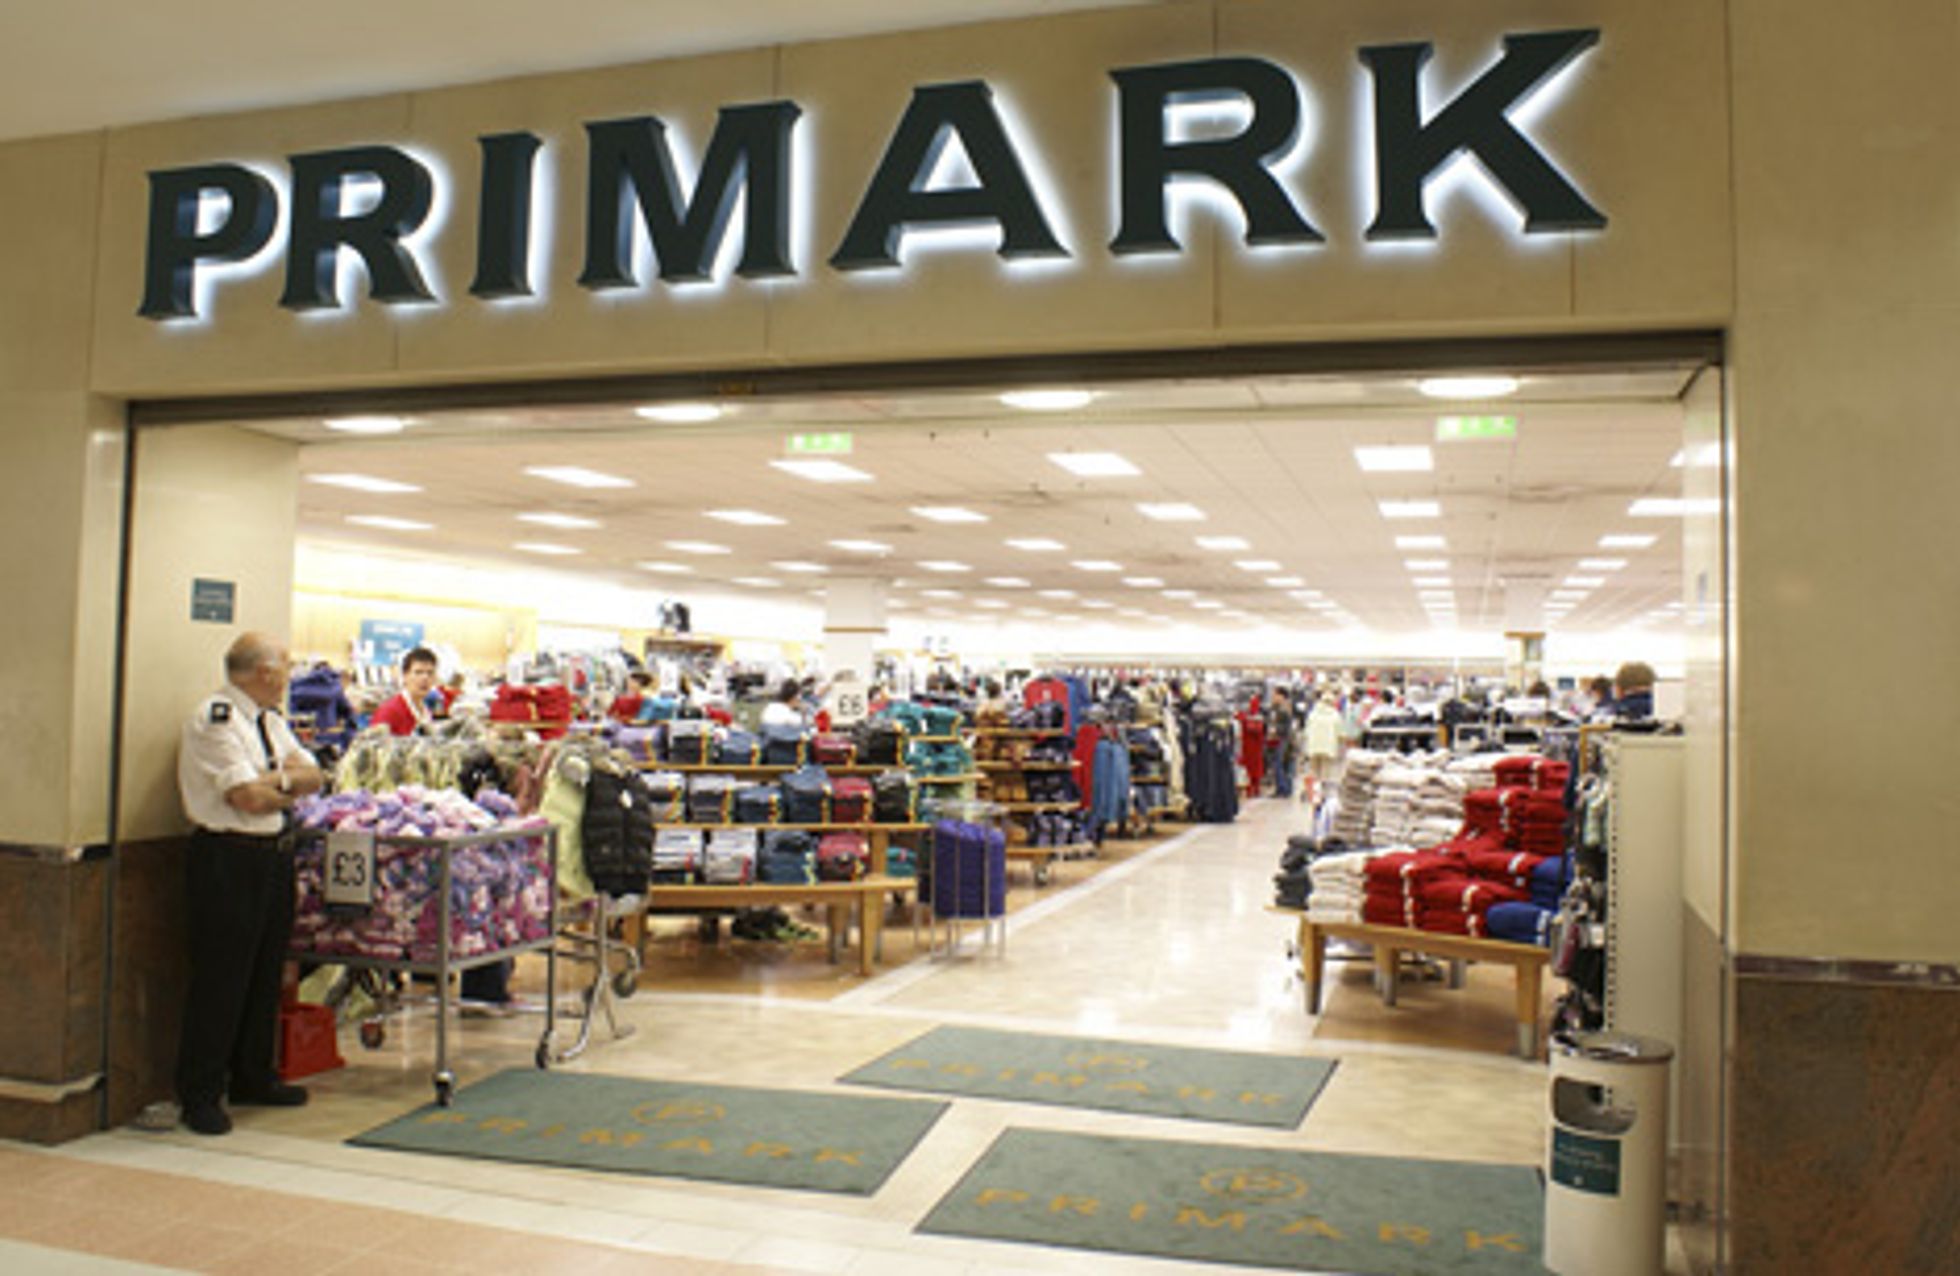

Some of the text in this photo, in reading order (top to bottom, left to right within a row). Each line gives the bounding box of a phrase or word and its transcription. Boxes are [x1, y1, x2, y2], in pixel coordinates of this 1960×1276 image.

[137, 28, 1609, 320] PRIMARK
[333, 851, 367, 886] £3
[417, 1111, 866, 1167] PRIMARK
[972, 1187, 1528, 1253] PRIMARK
